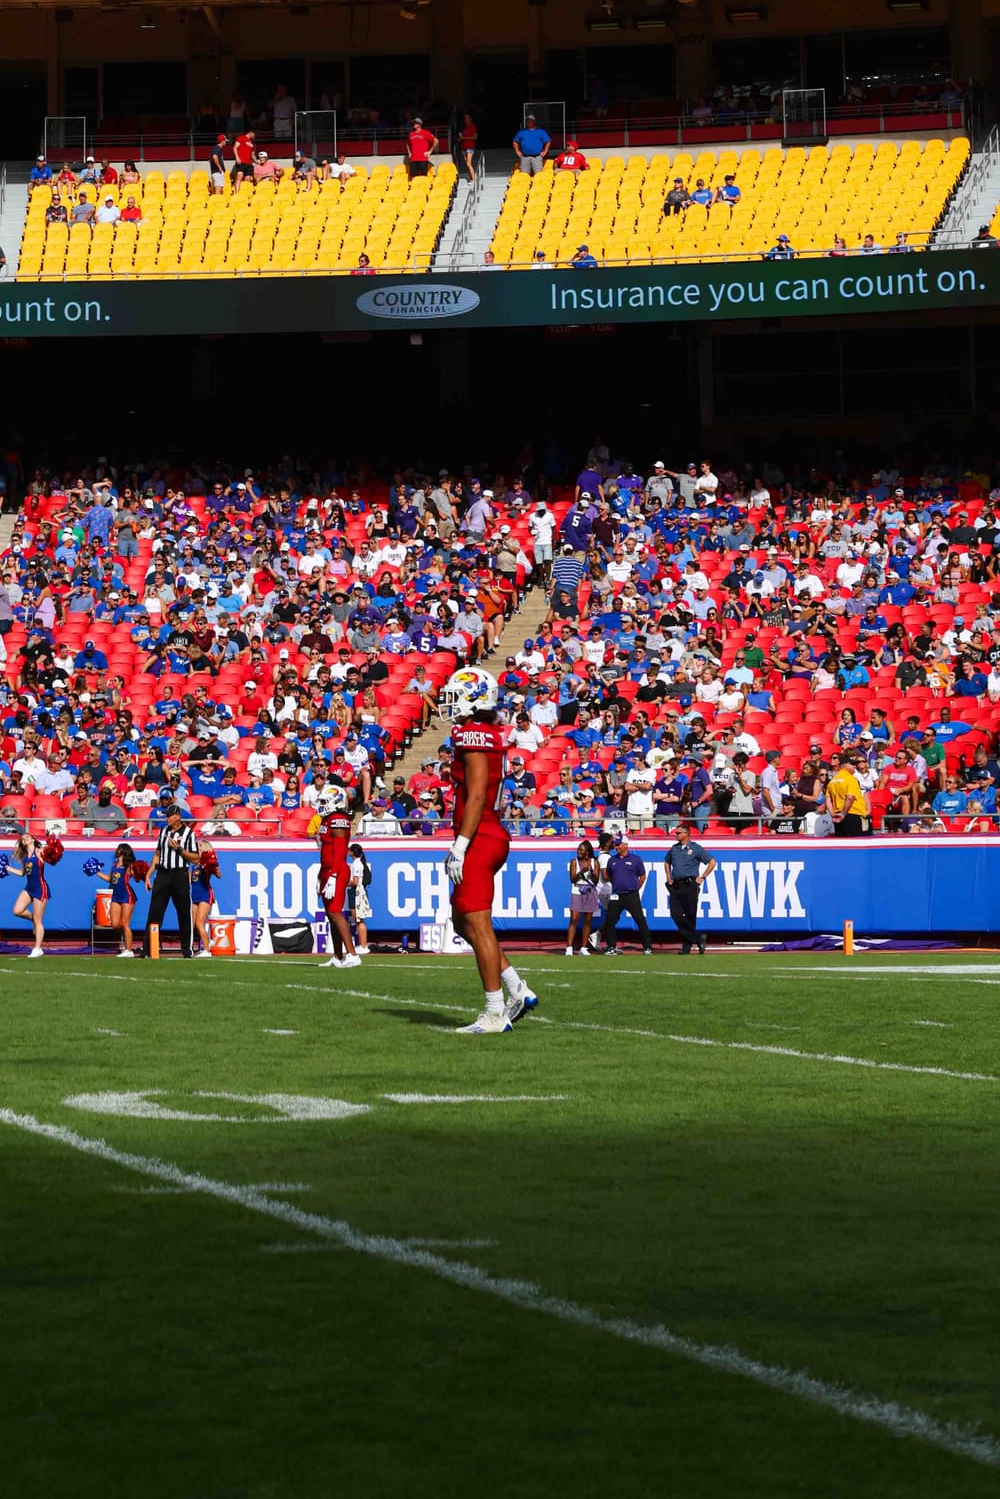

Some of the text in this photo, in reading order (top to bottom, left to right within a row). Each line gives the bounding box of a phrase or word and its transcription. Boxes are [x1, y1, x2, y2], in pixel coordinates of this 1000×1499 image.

[551, 268, 985, 312] Insurance you can count on.
[373, 289, 463, 308] COUNTRY
[64, 301, 110, 322] on.
[390, 304, 447, 314] FINANCIAL
[572, 515, 581, 527] 5
[421, 637, 431, 652] 5
[463, 730, 486, 739] ROCK
[462, 738, 486, 747] CHALK
[387, 861, 553, 918] CHLK
